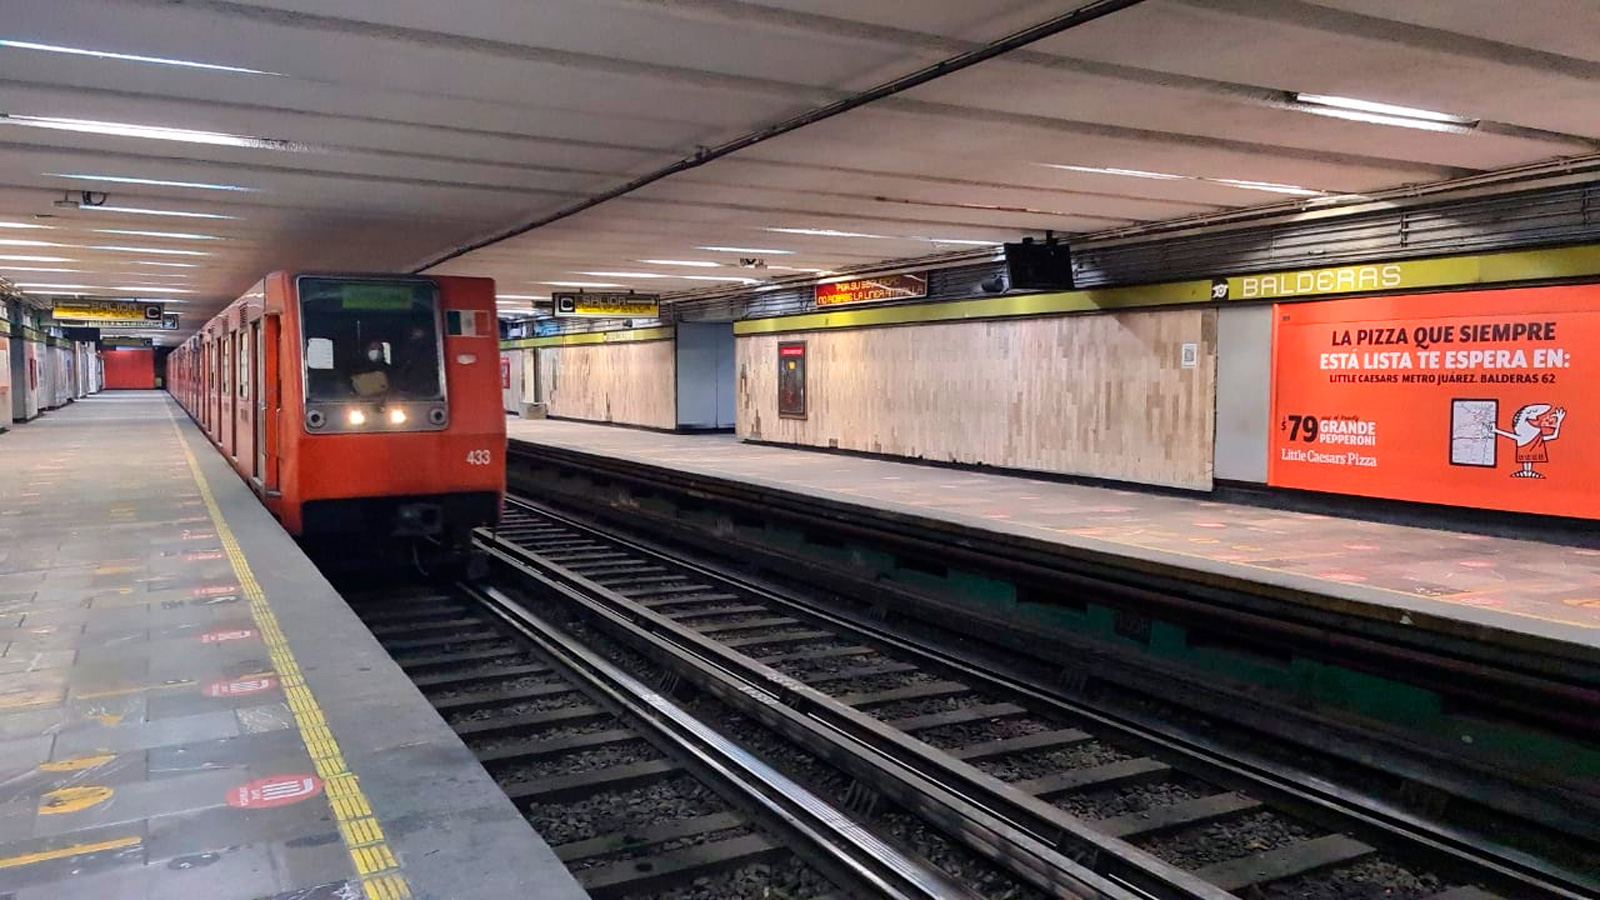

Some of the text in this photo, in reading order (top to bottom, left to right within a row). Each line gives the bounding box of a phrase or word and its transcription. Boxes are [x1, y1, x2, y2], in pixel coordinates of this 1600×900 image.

[1243, 265, 1400, 297] BALDERAS
[561, 297, 575, 311] C
[583, 294, 626, 306] SALIDA
[854, 291, 863, 300] LA
[146, 306, 159, 318] C
[1332, 322, 1556, 349] LA PIZZA QUE SIEMPRE
[1320, 348, 1570, 369] ESTÁ LISTA TE ESPERA EN:
[1329, 375, 1356, 383] LITTLE
[1358, 375, 1398, 383] CAESARS
[1402, 375, 1435, 383] METRO
[1480, 374, 1539, 383] BALDERAS
[1541, 374, 1556, 383] 62
[1320, 420, 1376, 435] GRANDE
[1320, 434, 1376, 446] PEPPERONI
[467, 449, 490, 465] 433
[1281, 448, 1377, 467] Little Caesars Pizza
